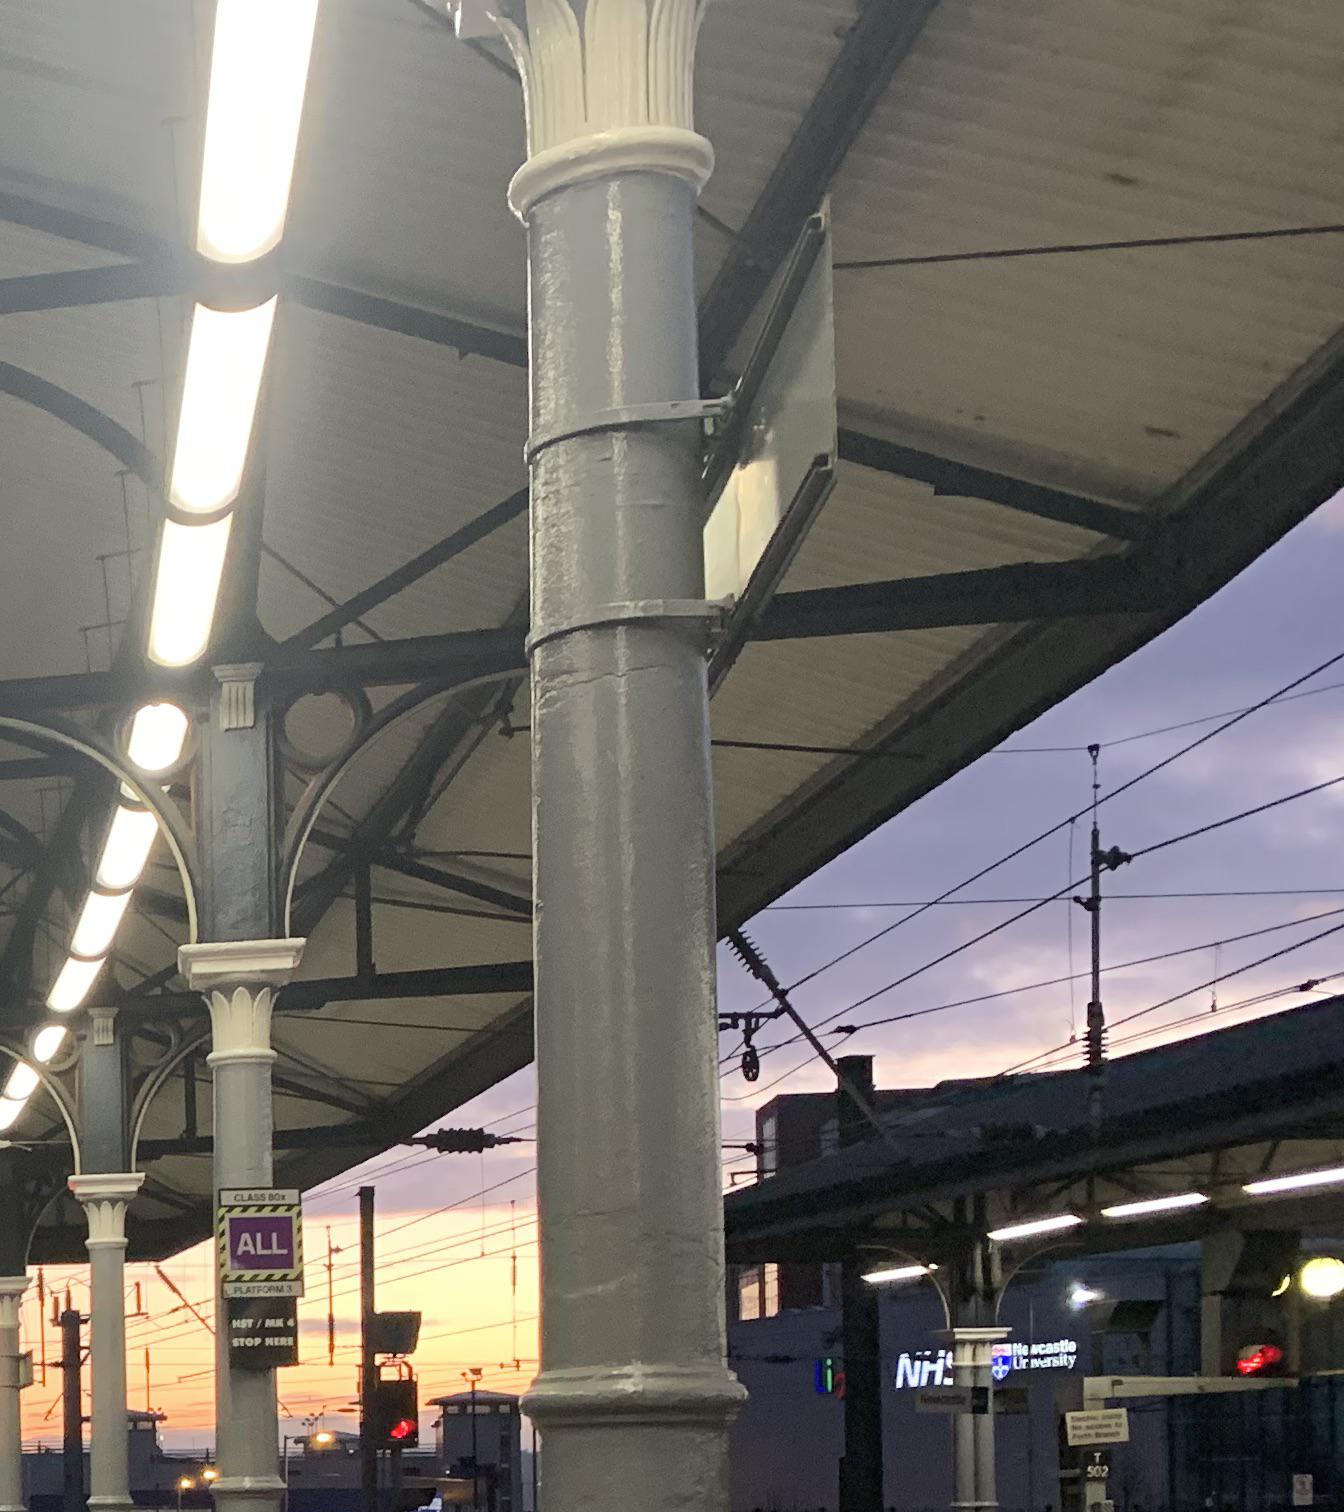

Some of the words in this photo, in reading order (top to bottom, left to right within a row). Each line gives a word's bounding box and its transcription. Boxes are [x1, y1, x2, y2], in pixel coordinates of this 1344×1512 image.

[234, 1193, 266, 1201] CLASS
[236, 1232, 288, 1255] ALL
[233, 1285, 284, 1295] PLATFORM
[232, 1336, 262, 1347] STOP
[265, 1336, 294, 1346] HERE
[1093, 1452, 1102, 1464] T
[1087, 1465, 1109, 1478] 502
